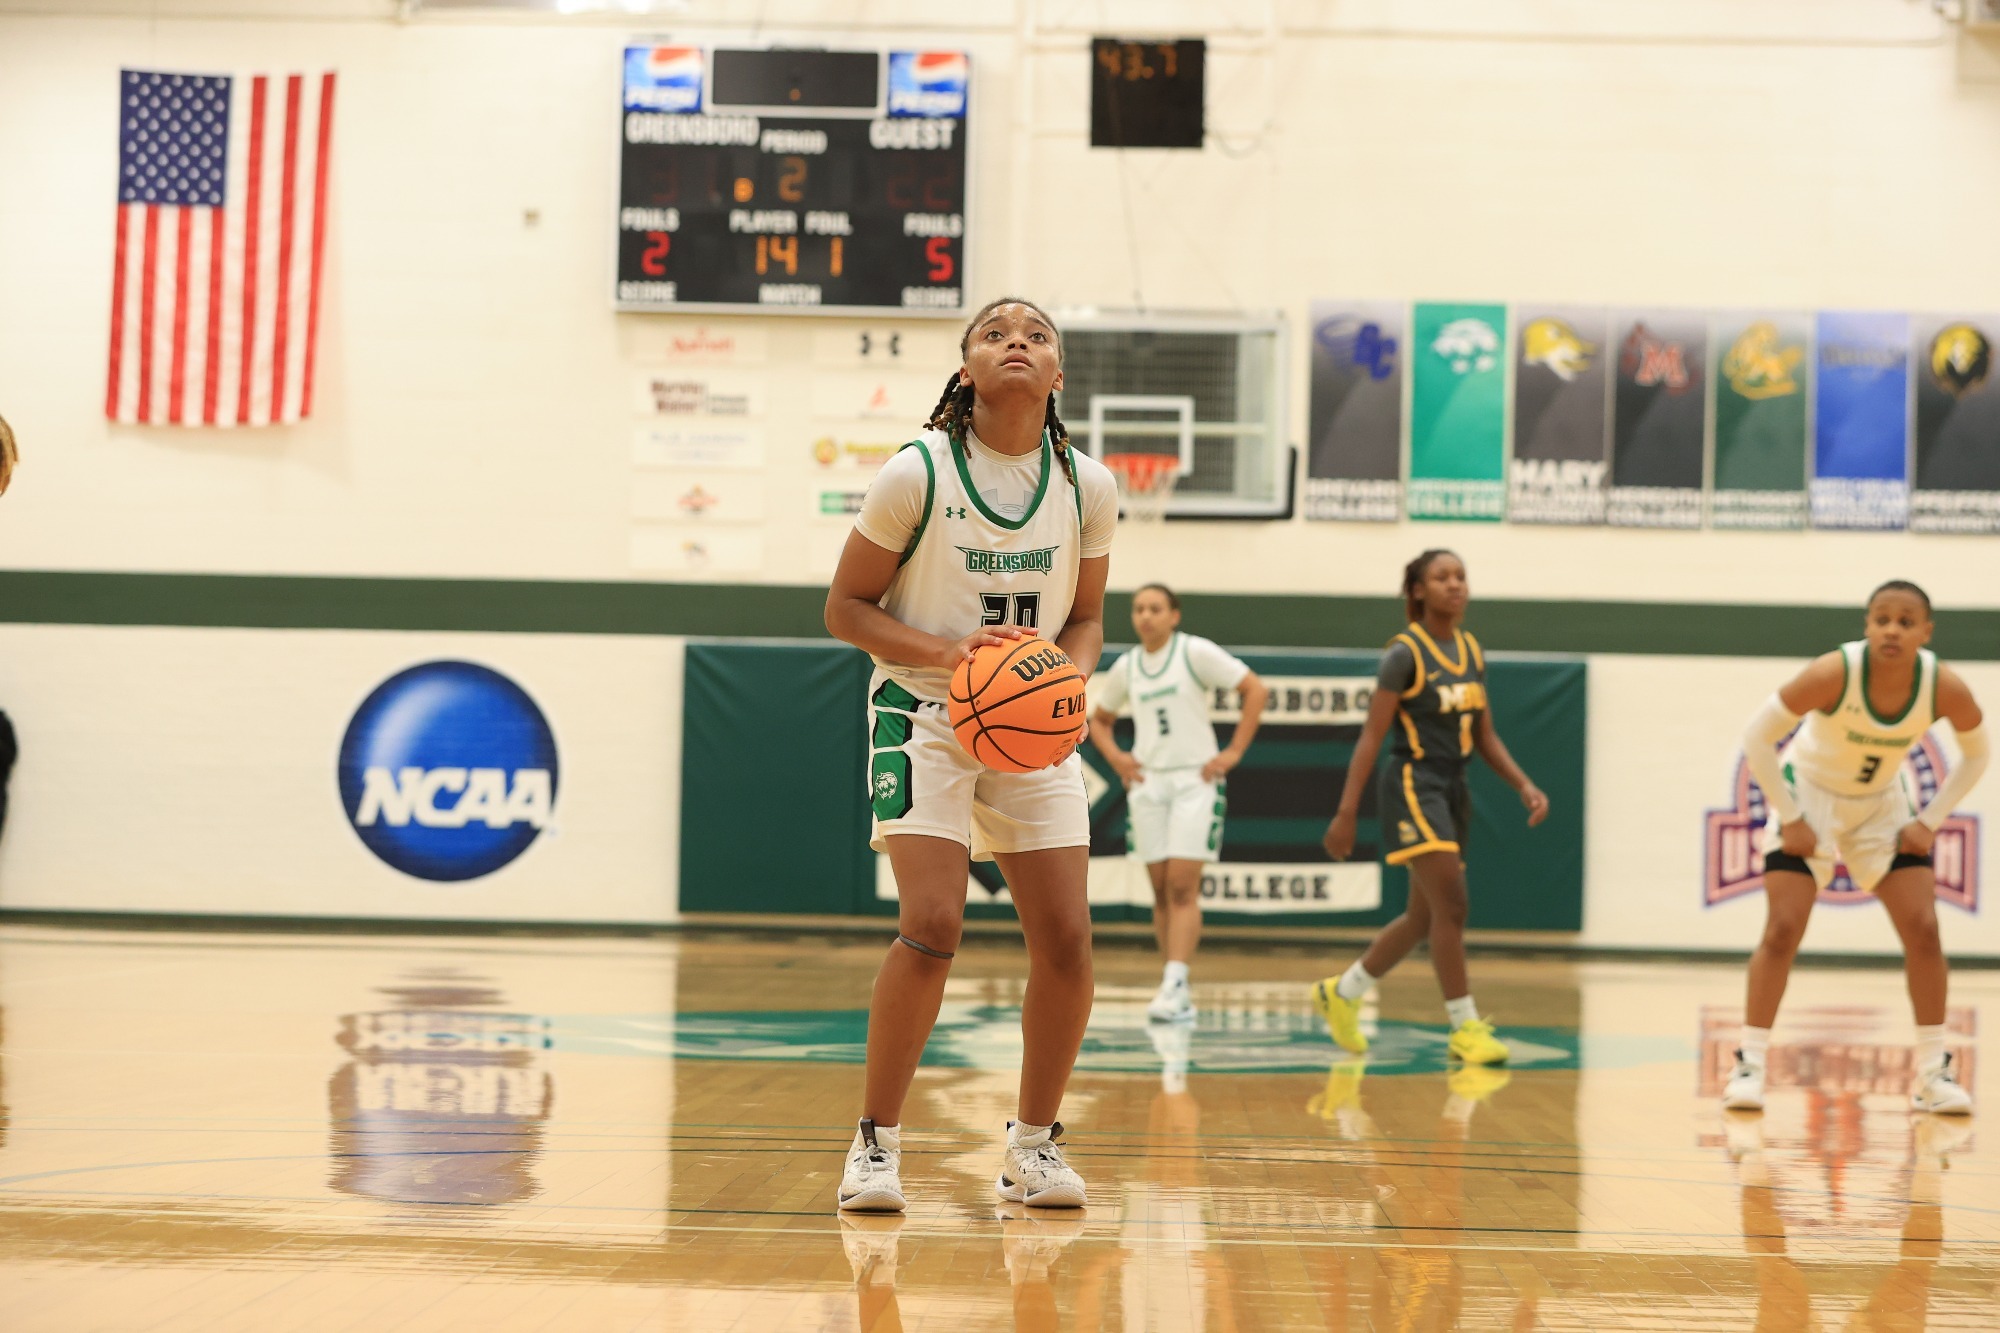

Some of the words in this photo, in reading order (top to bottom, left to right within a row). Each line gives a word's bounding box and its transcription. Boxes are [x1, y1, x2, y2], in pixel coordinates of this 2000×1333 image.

[625, 115, 760, 145] GREENSBORO
[760, 129, 828, 154] PERIOD
[869, 117, 956, 149] GUEST
[778, 156, 807, 202] 2
[621, 208, 680, 232] FOULS
[729, 209, 798, 233] PLAYER
[804, 210, 853, 235] FOUL
[903, 213, 963, 238] FOULS
[641, 231, 671, 276] 2
[755, 235, 799, 276] 14
[830, 236, 843, 278] 1
[925, 236, 954, 282] 5
[1509, 460, 1609, 488] MARY
[965, 549, 1054, 575] GREENSBORO
[1010, 648, 1074, 682] Wilso
[1856, 754, 1882, 784] 3
[355, 766, 552, 829] NCAA
[1201, 875, 1330, 900] OLLEGE
